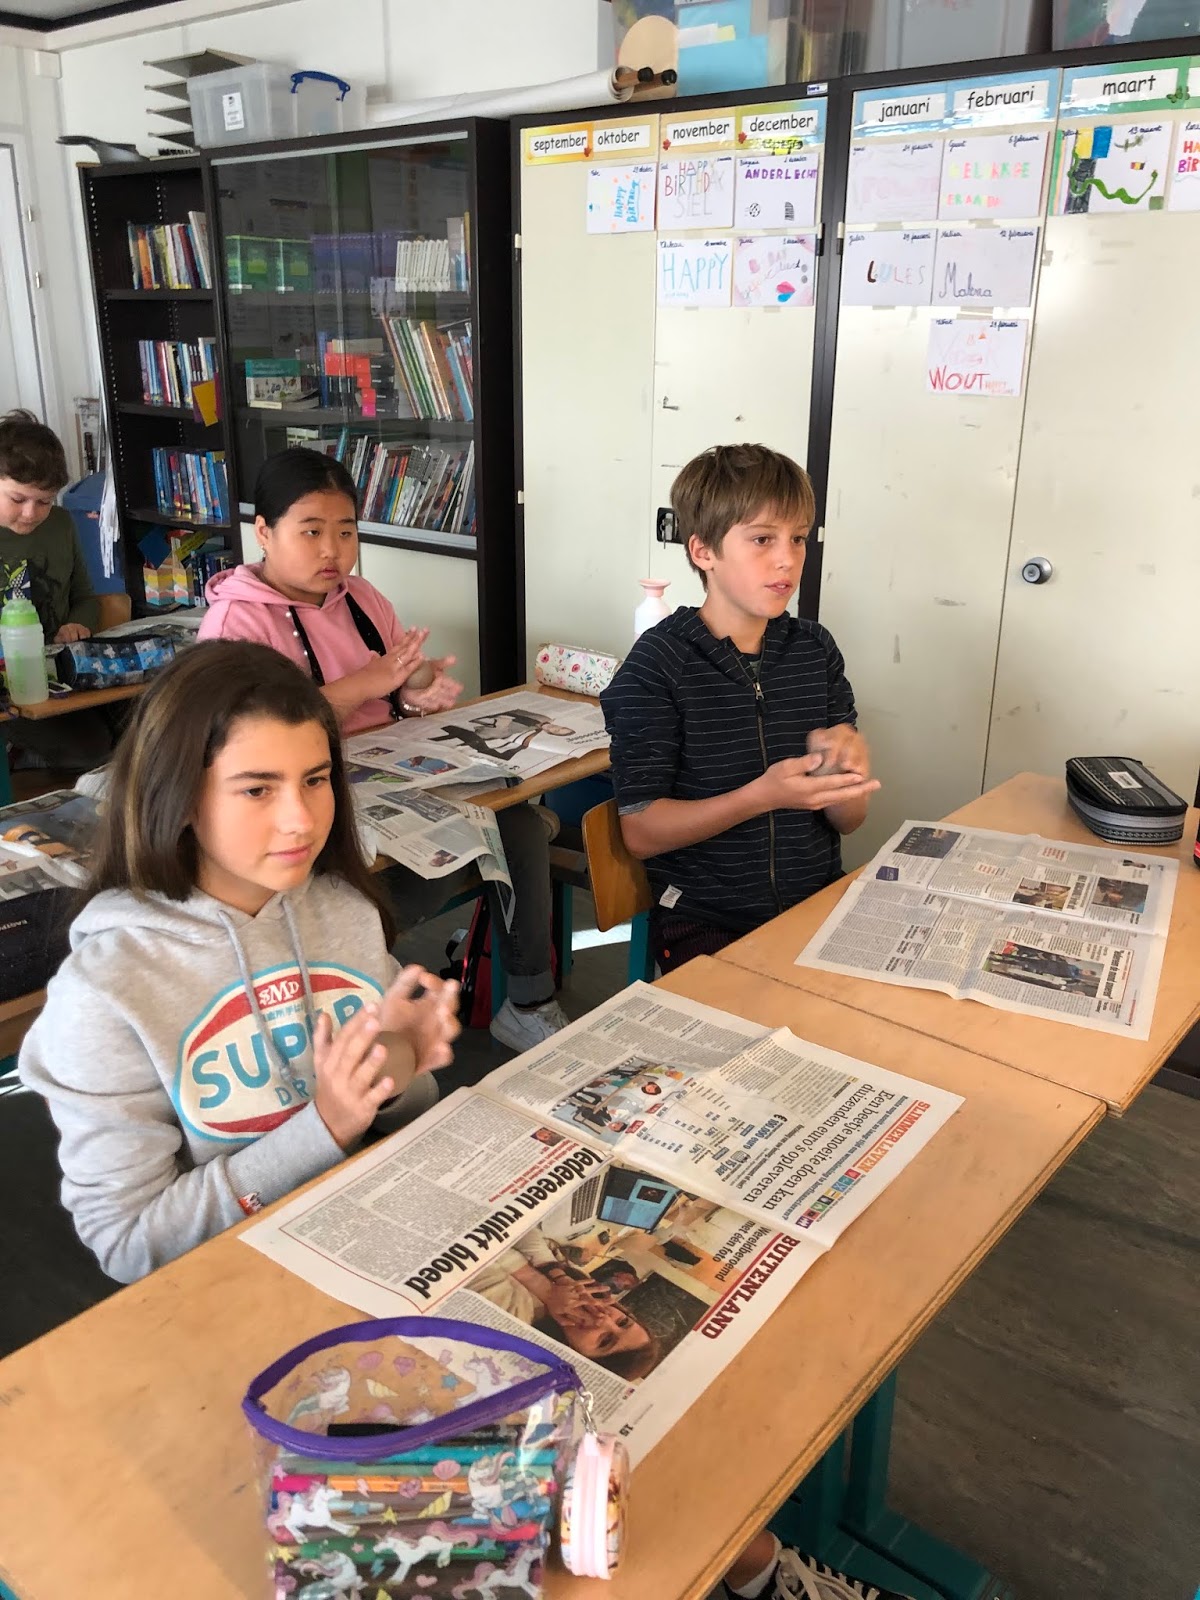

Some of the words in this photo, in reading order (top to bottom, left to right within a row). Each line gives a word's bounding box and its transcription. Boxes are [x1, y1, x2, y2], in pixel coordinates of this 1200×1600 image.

[967, 85, 1035, 110] februari
[1102, 75, 1156, 96] maart
[879, 97, 930, 122] januari
[673, 121, 730, 140] november
[749, 114, 813, 133] december
[533, 135, 587, 153] september
[597, 130, 640, 146] oktober
[663, 252, 728, 292] HAPPY
[929, 365, 991, 391] WOUT
[822, 1082, 875, 1129] duizenden
[867, 1089, 895, 1108] Een
[840, 1107, 875, 1137] beetje
[884, 1101, 929, 1144] SLIMMER
[794, 1125, 828, 1154] euro's
[809, 1134, 846, 1167] moeite
[857, 1139, 892, 1173] LEVEN
[512, 1145, 603, 1211] Iedereen
[742, 1151, 799, 1202] opleveren
[783, 1162, 814, 1187] doen
[761, 1187, 791, 1211] kan
[463, 1203, 522, 1254] ruikt
[738, 1219, 756, 1235] met
[726, 1232, 744, 1249] één
[711, 1245, 732, 1263] foto
[713, 1226, 770, 1282] Wereldberoemd
[404, 1241, 478, 1301] bloed
[700, 1235, 799, 1339] BUITENLAND
[618, 1423, 634, 1437] 15
